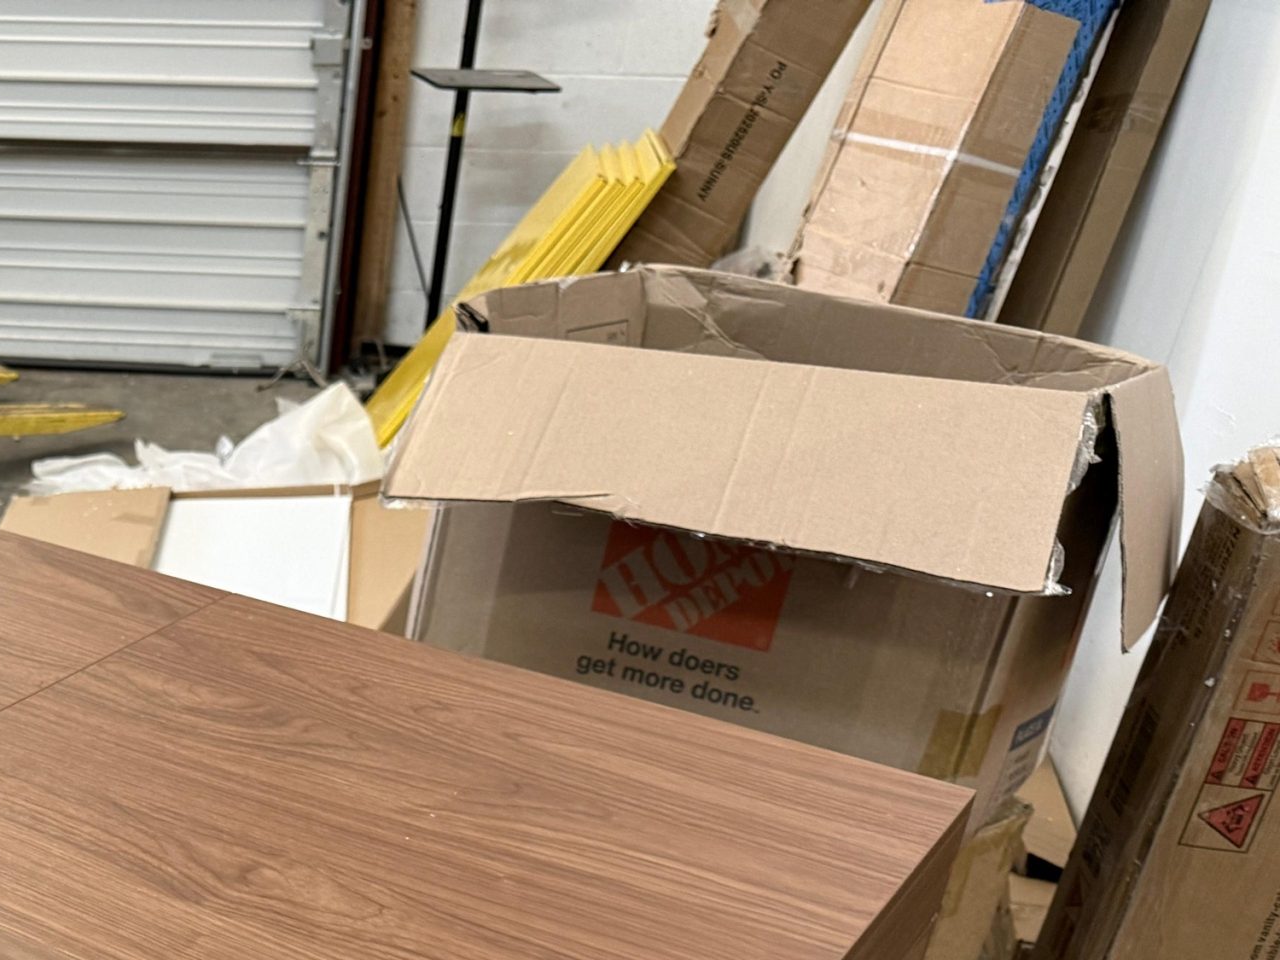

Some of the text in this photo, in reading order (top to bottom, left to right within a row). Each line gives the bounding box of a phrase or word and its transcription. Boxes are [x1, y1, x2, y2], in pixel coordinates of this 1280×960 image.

[599, 528, 738, 620] HO
[576, 653, 760, 714] get more done.
[607, 631, 740, 681] How doers
